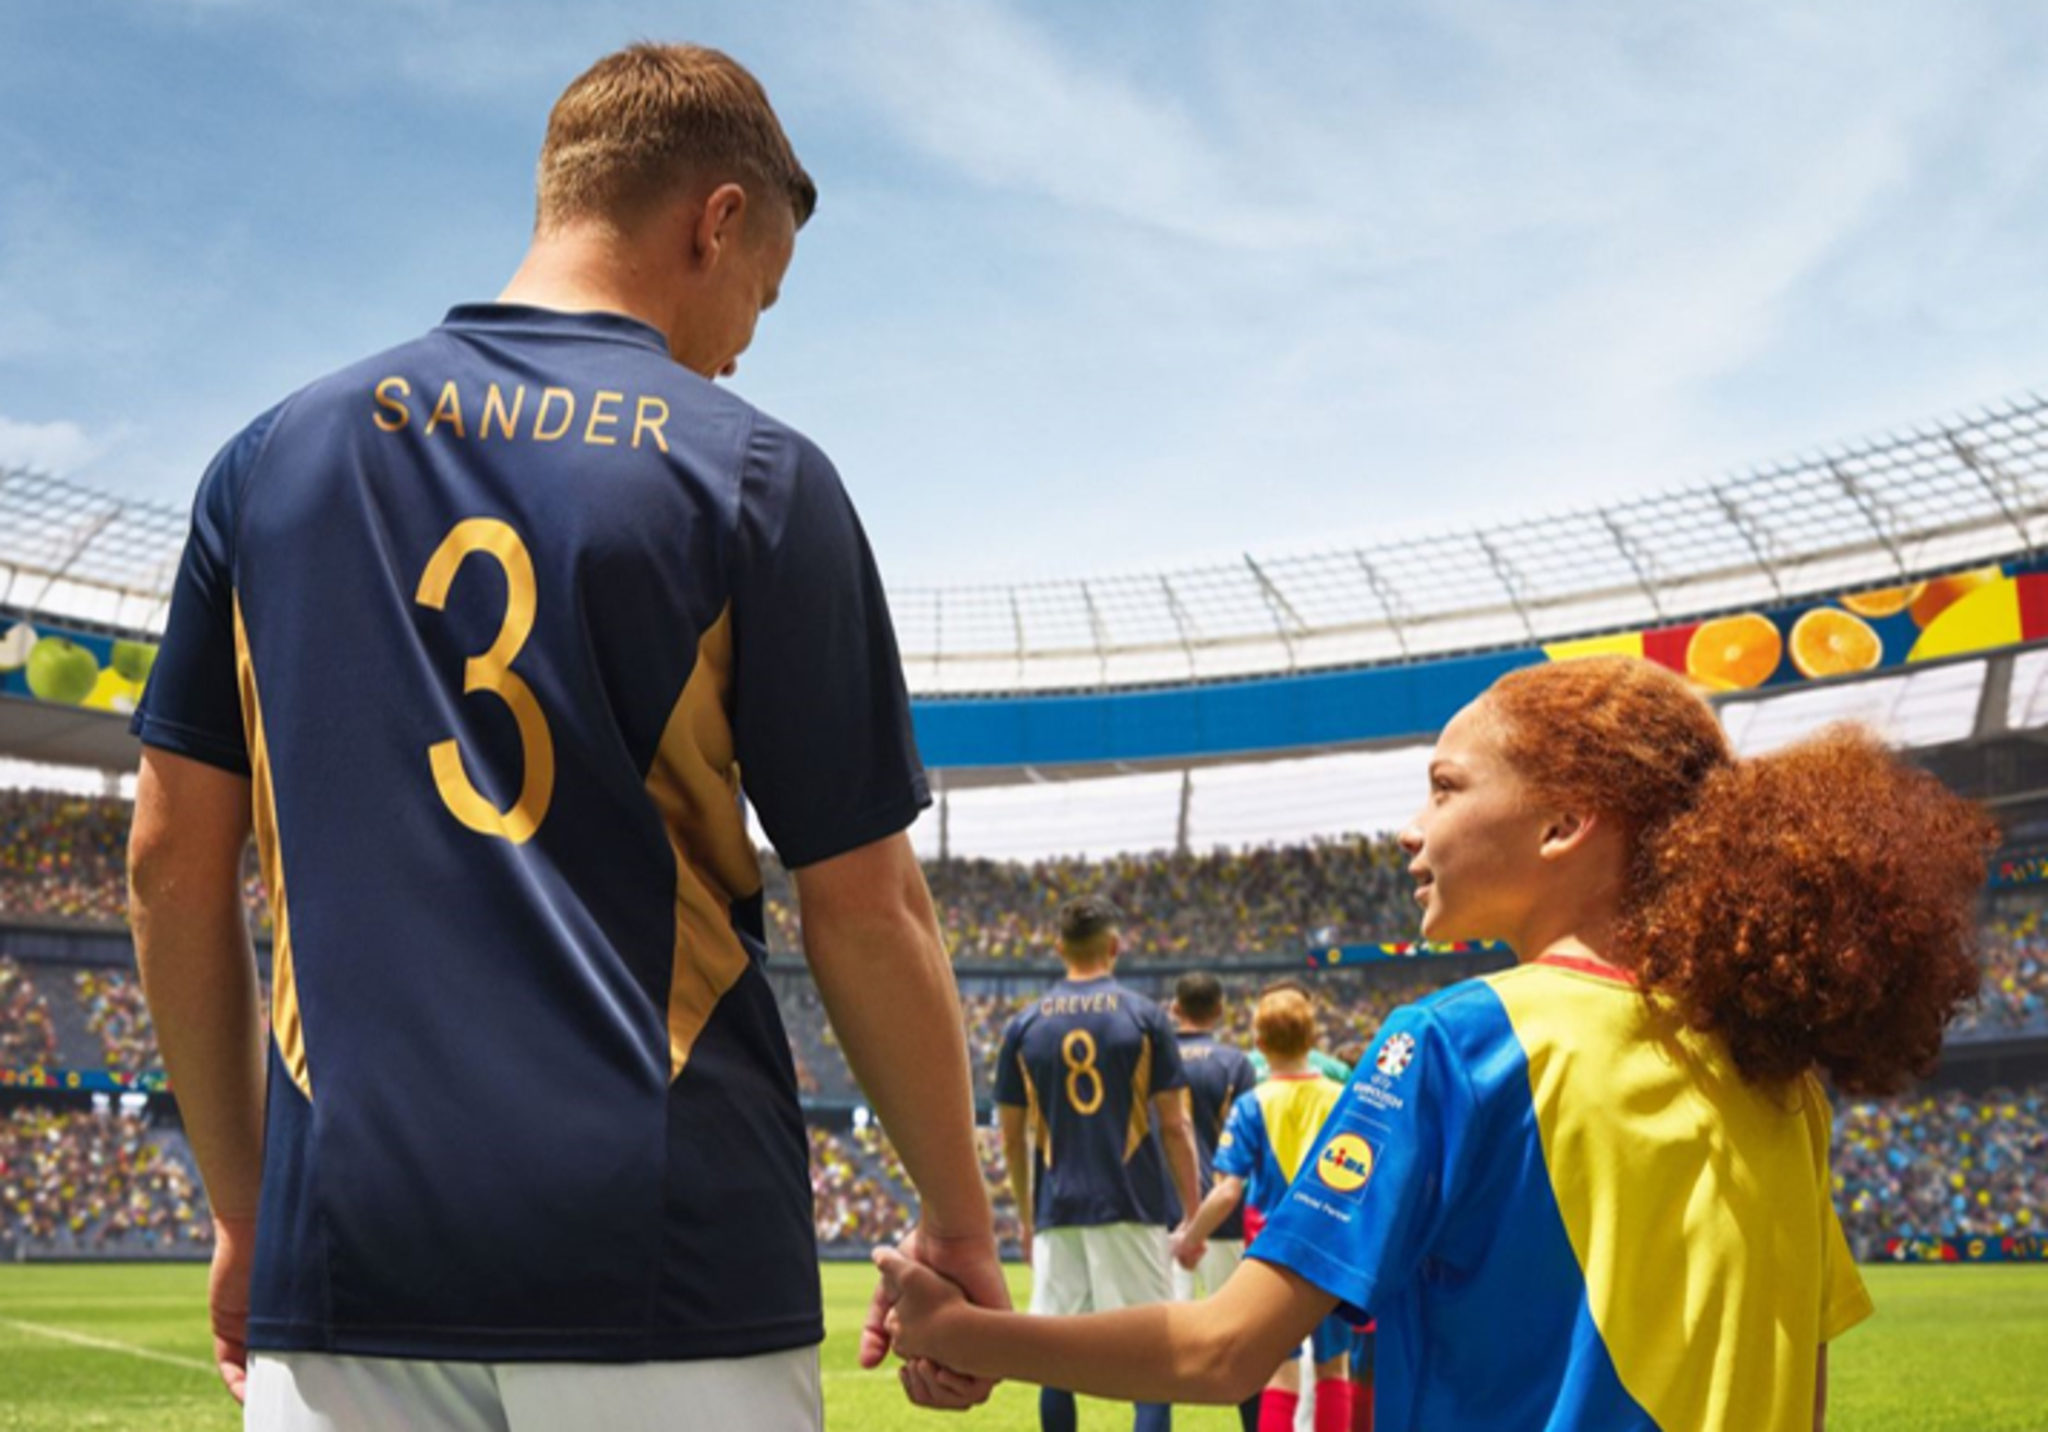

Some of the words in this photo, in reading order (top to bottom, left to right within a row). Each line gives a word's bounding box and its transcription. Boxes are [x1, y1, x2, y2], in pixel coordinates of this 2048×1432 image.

[373, 377, 670, 453] SANDER
[415, 517, 555, 845] 3
[1041, 992, 1118, 1018] GREVEN
[1062, 1028, 1104, 1117] 8
